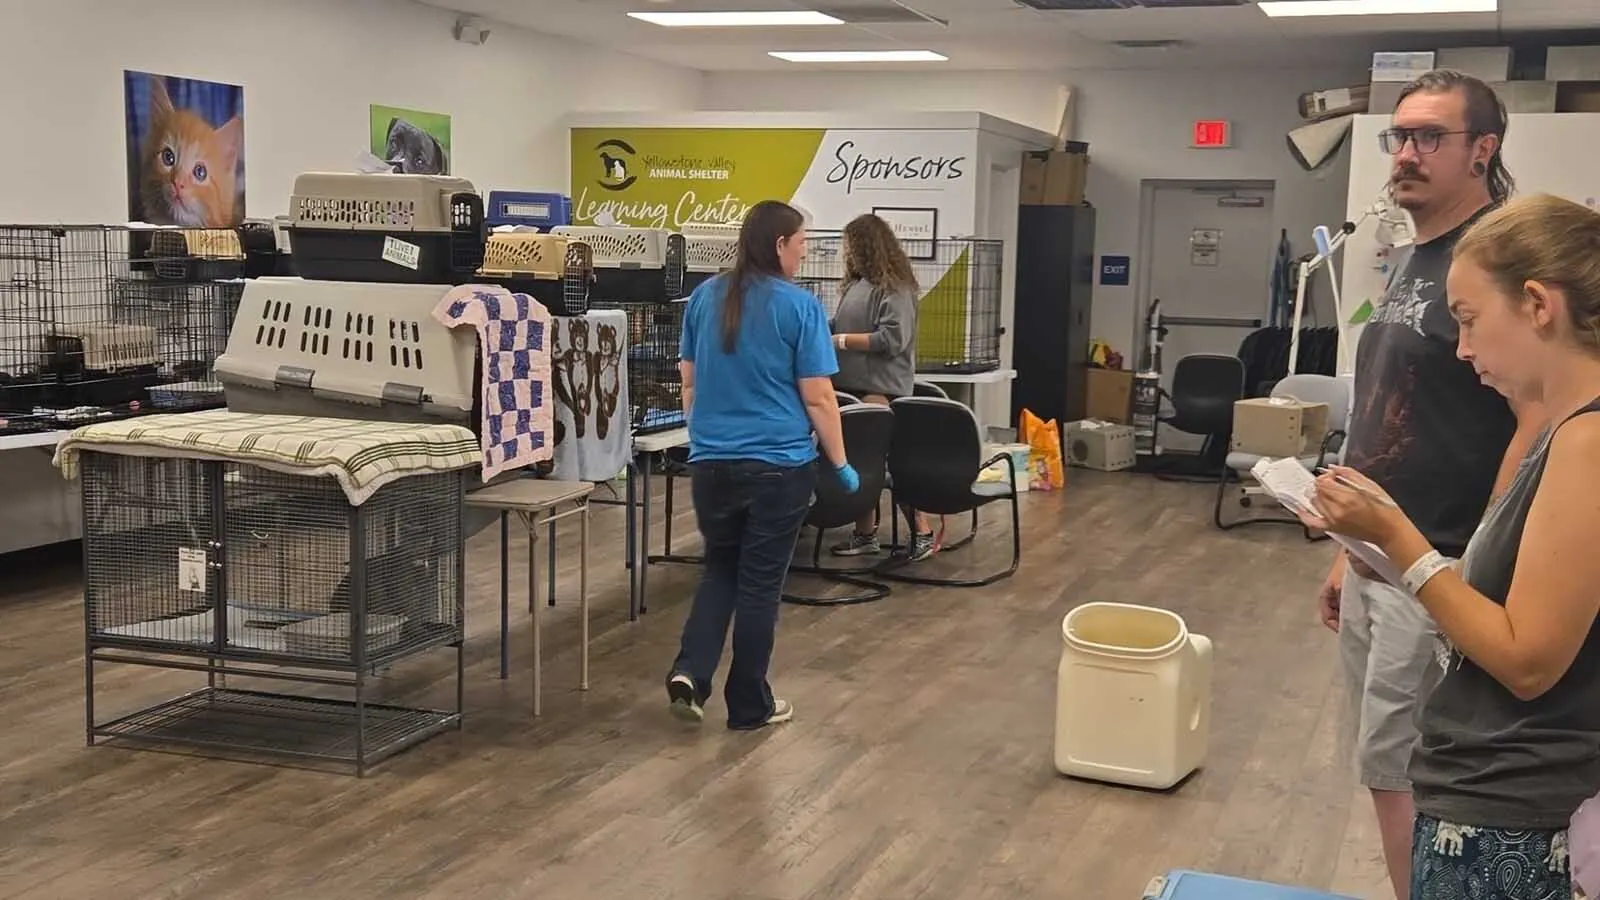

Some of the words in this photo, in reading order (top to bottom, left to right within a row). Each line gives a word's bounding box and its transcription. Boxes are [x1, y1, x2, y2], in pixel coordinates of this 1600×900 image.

[648, 168, 687, 179] ANIMAL
[688, 169, 729, 180] SHELTER
[826, 140, 966, 194] Sponsors
[575, 186, 669, 230] Learning
[674, 191, 752, 227] Center
[1103, 265, 1126, 274] EXIT
